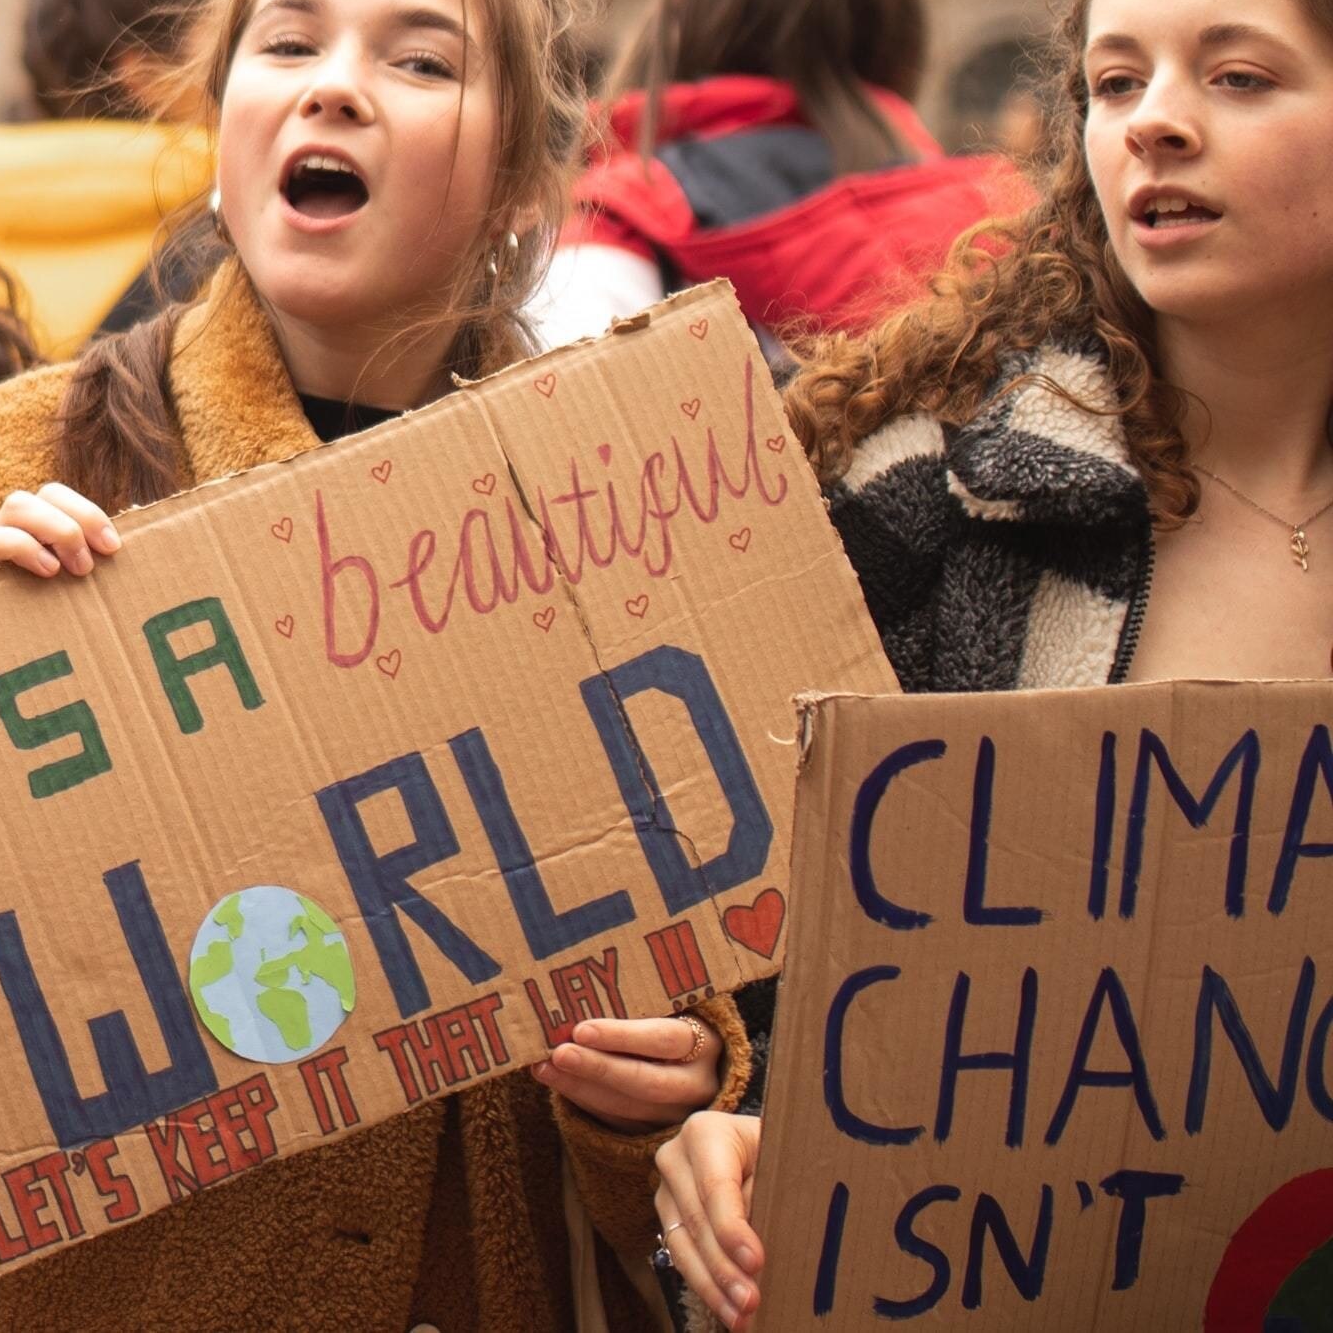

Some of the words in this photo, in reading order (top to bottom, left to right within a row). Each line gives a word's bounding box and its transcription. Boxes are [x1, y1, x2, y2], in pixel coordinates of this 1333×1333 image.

[314, 351, 789, 668] beautiful
[141, 595, 267, 735] A
[144, 1071, 278, 1203] KEEP
[296, 1045, 362, 1137] IT
[372, 991, 513, 1107] THAT
[522, 945, 630, 1050] WAY
[811, 1167, 1187, 1320] ISN'T
